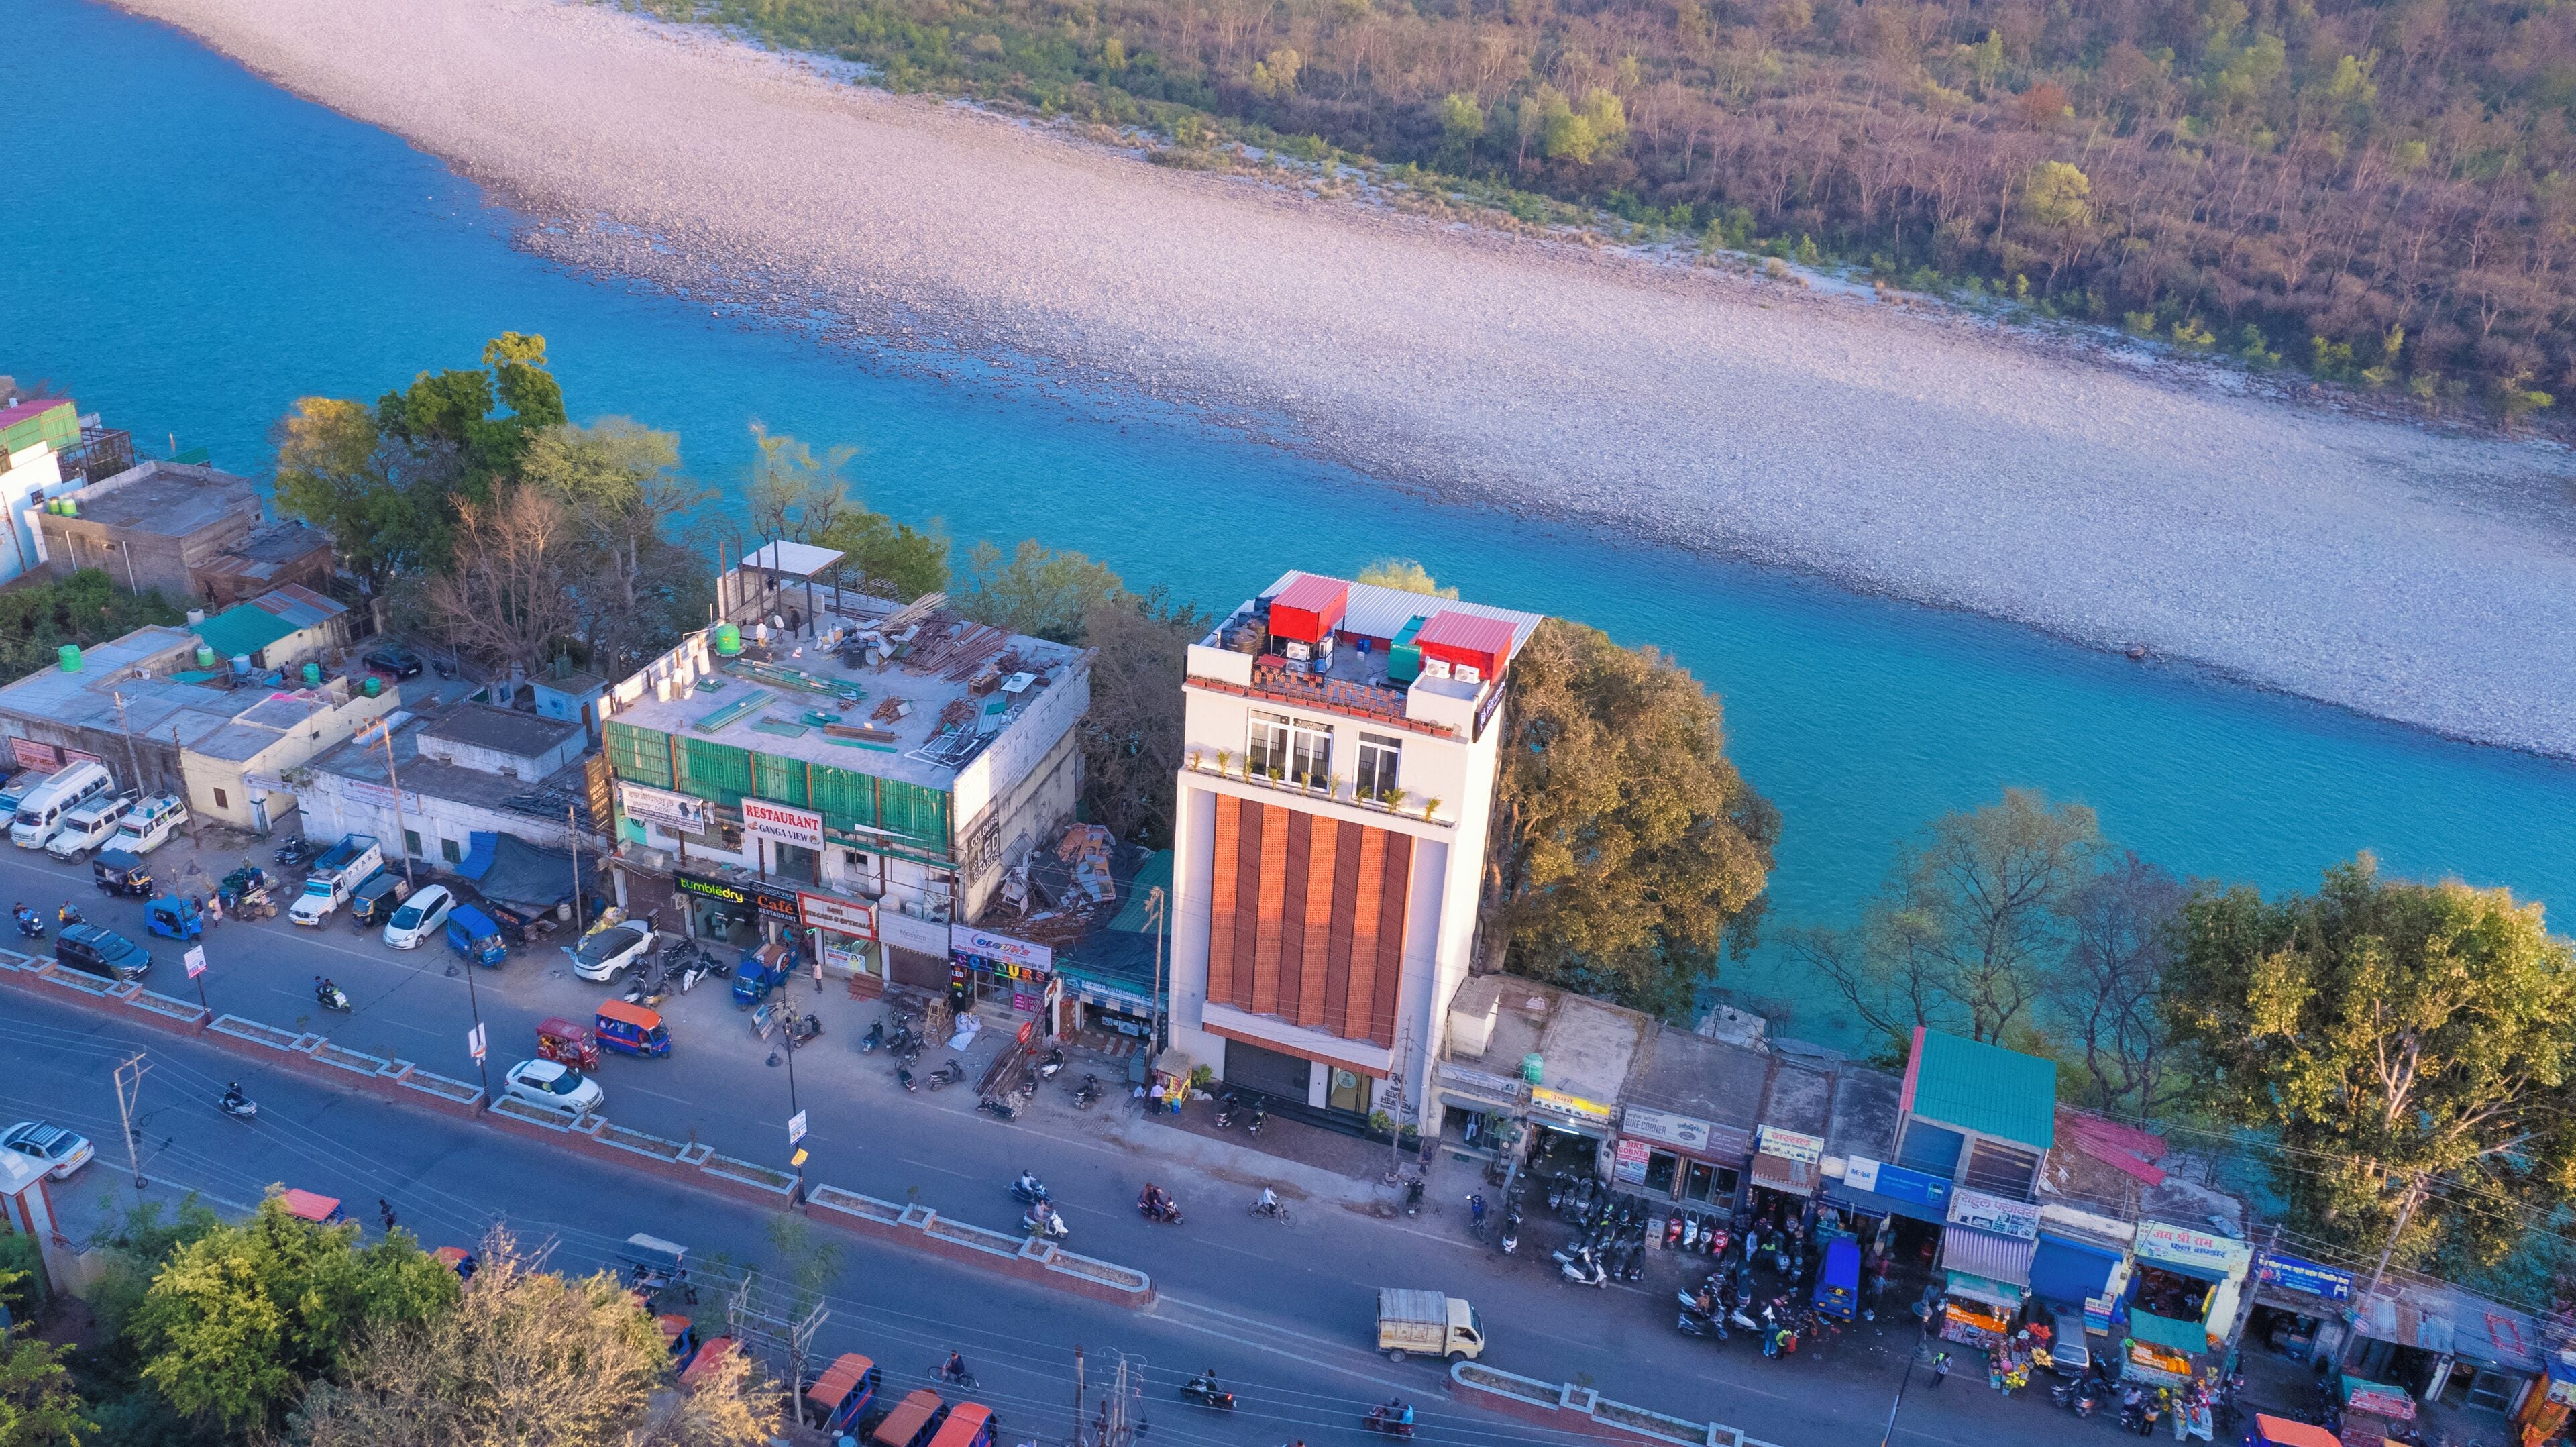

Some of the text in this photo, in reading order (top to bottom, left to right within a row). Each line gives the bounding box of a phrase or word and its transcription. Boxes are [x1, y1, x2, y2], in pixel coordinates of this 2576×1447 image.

[746, 805, 818, 830] RESTAURANT
[759, 824, 808, 842] GANGA VIEW
[971, 813, 998, 847] COLOURS
[977, 833, 999, 867] LED
[973, 851, 999, 882] BOARDS
[757, 896, 794, 915] Café
[758, 907, 796, 922] RESTAURANT
[951, 970, 964, 978] LED
[957, 954, 1045, 983] COLOURS
[1081, 979, 1106, 989] KAPOOR
[1381, 1095, 1411, 1110] HEAEN
[1385, 1089, 1407, 1101] RIVR
[1625, 1118, 1640, 1128] BIKE
[1641, 1121, 1666, 1135] CORNER
[1618, 1147, 1648, 1159] CORNER
[1626, 1141, 1644, 1150] BIKE
[1851, 1168, 1870, 1179] Mobil
[2153, 1230, 2214, 1248] जय श्री राम
